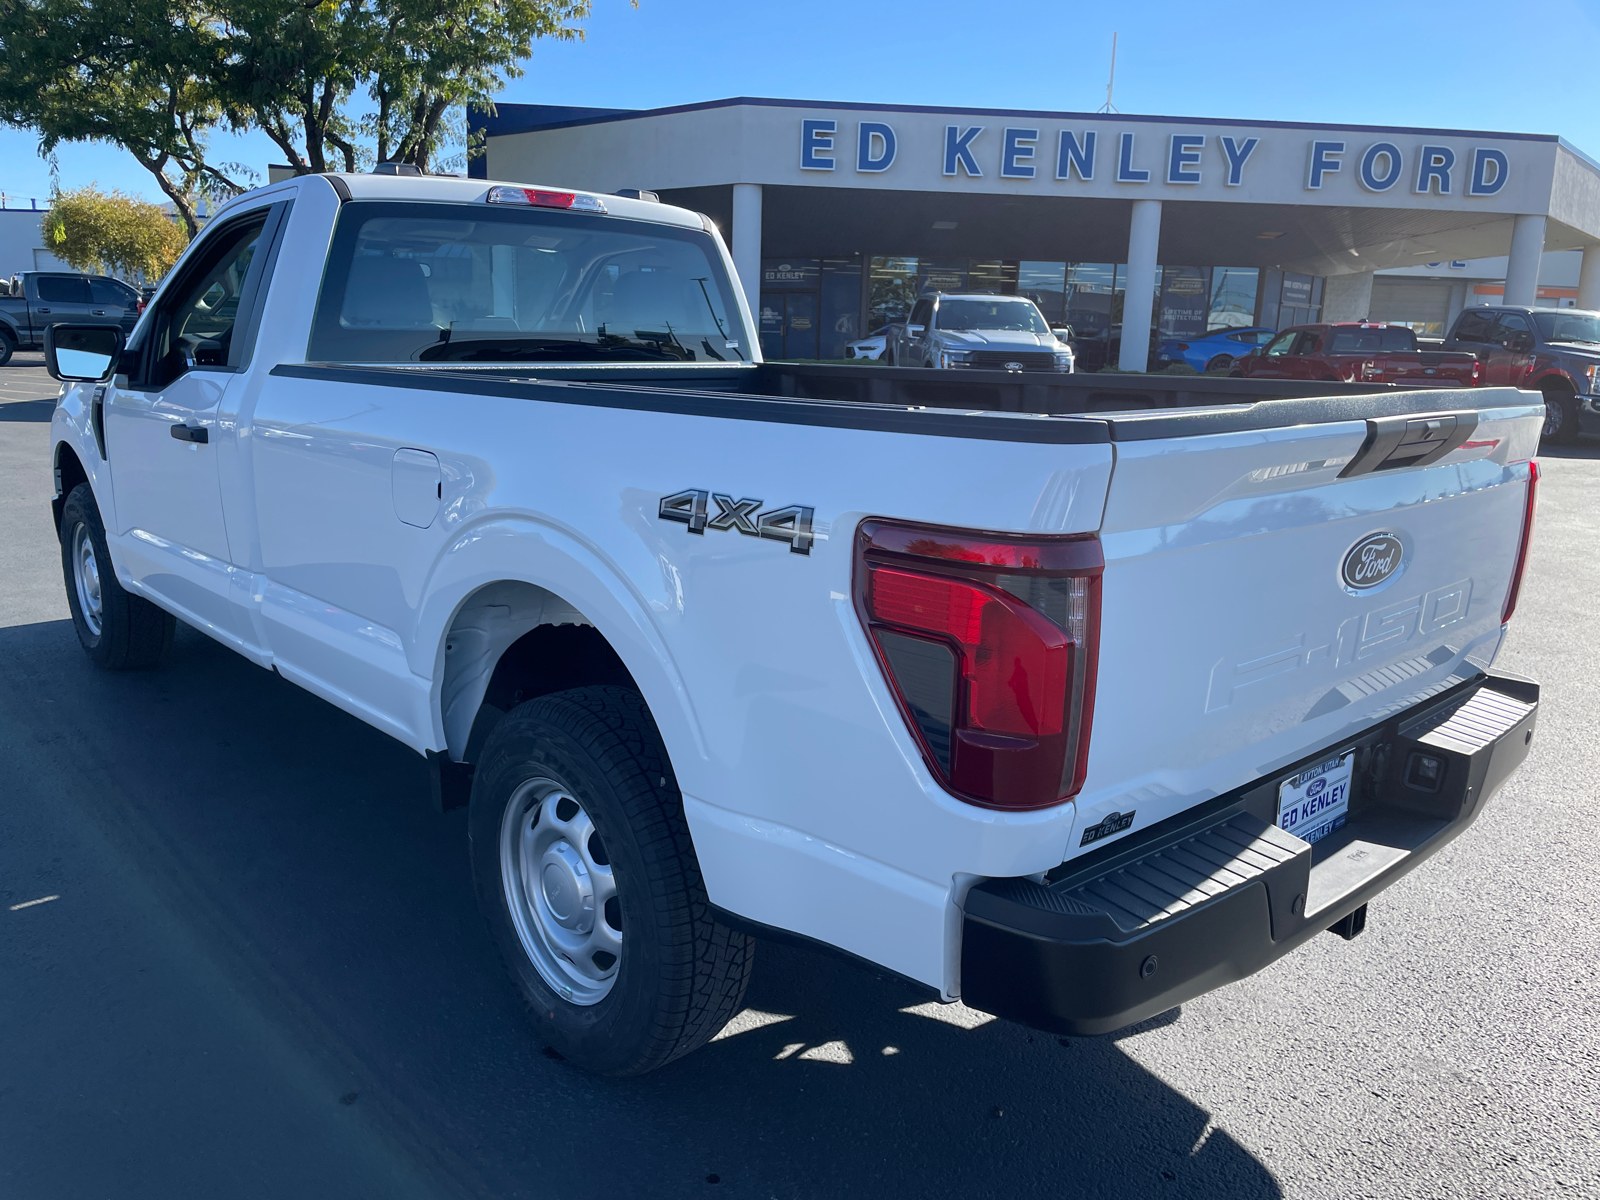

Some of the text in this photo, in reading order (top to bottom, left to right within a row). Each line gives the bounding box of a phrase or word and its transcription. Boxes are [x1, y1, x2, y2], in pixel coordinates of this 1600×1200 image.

[800, 118, 1510, 196] ED KENLEY FORD
[1355, 543, 1395, 581] Ford
[1204, 578, 1474, 714] F-150
[1324, 757, 1340, 771] UTAH
[1281, 807, 1298, 830] ED
[1301, 782, 1347, 820] KENLEY
[1309, 780, 1323, 796] Ford
[1082, 830, 1096, 842] ED
[1097, 815, 1134, 838] KENLEY
